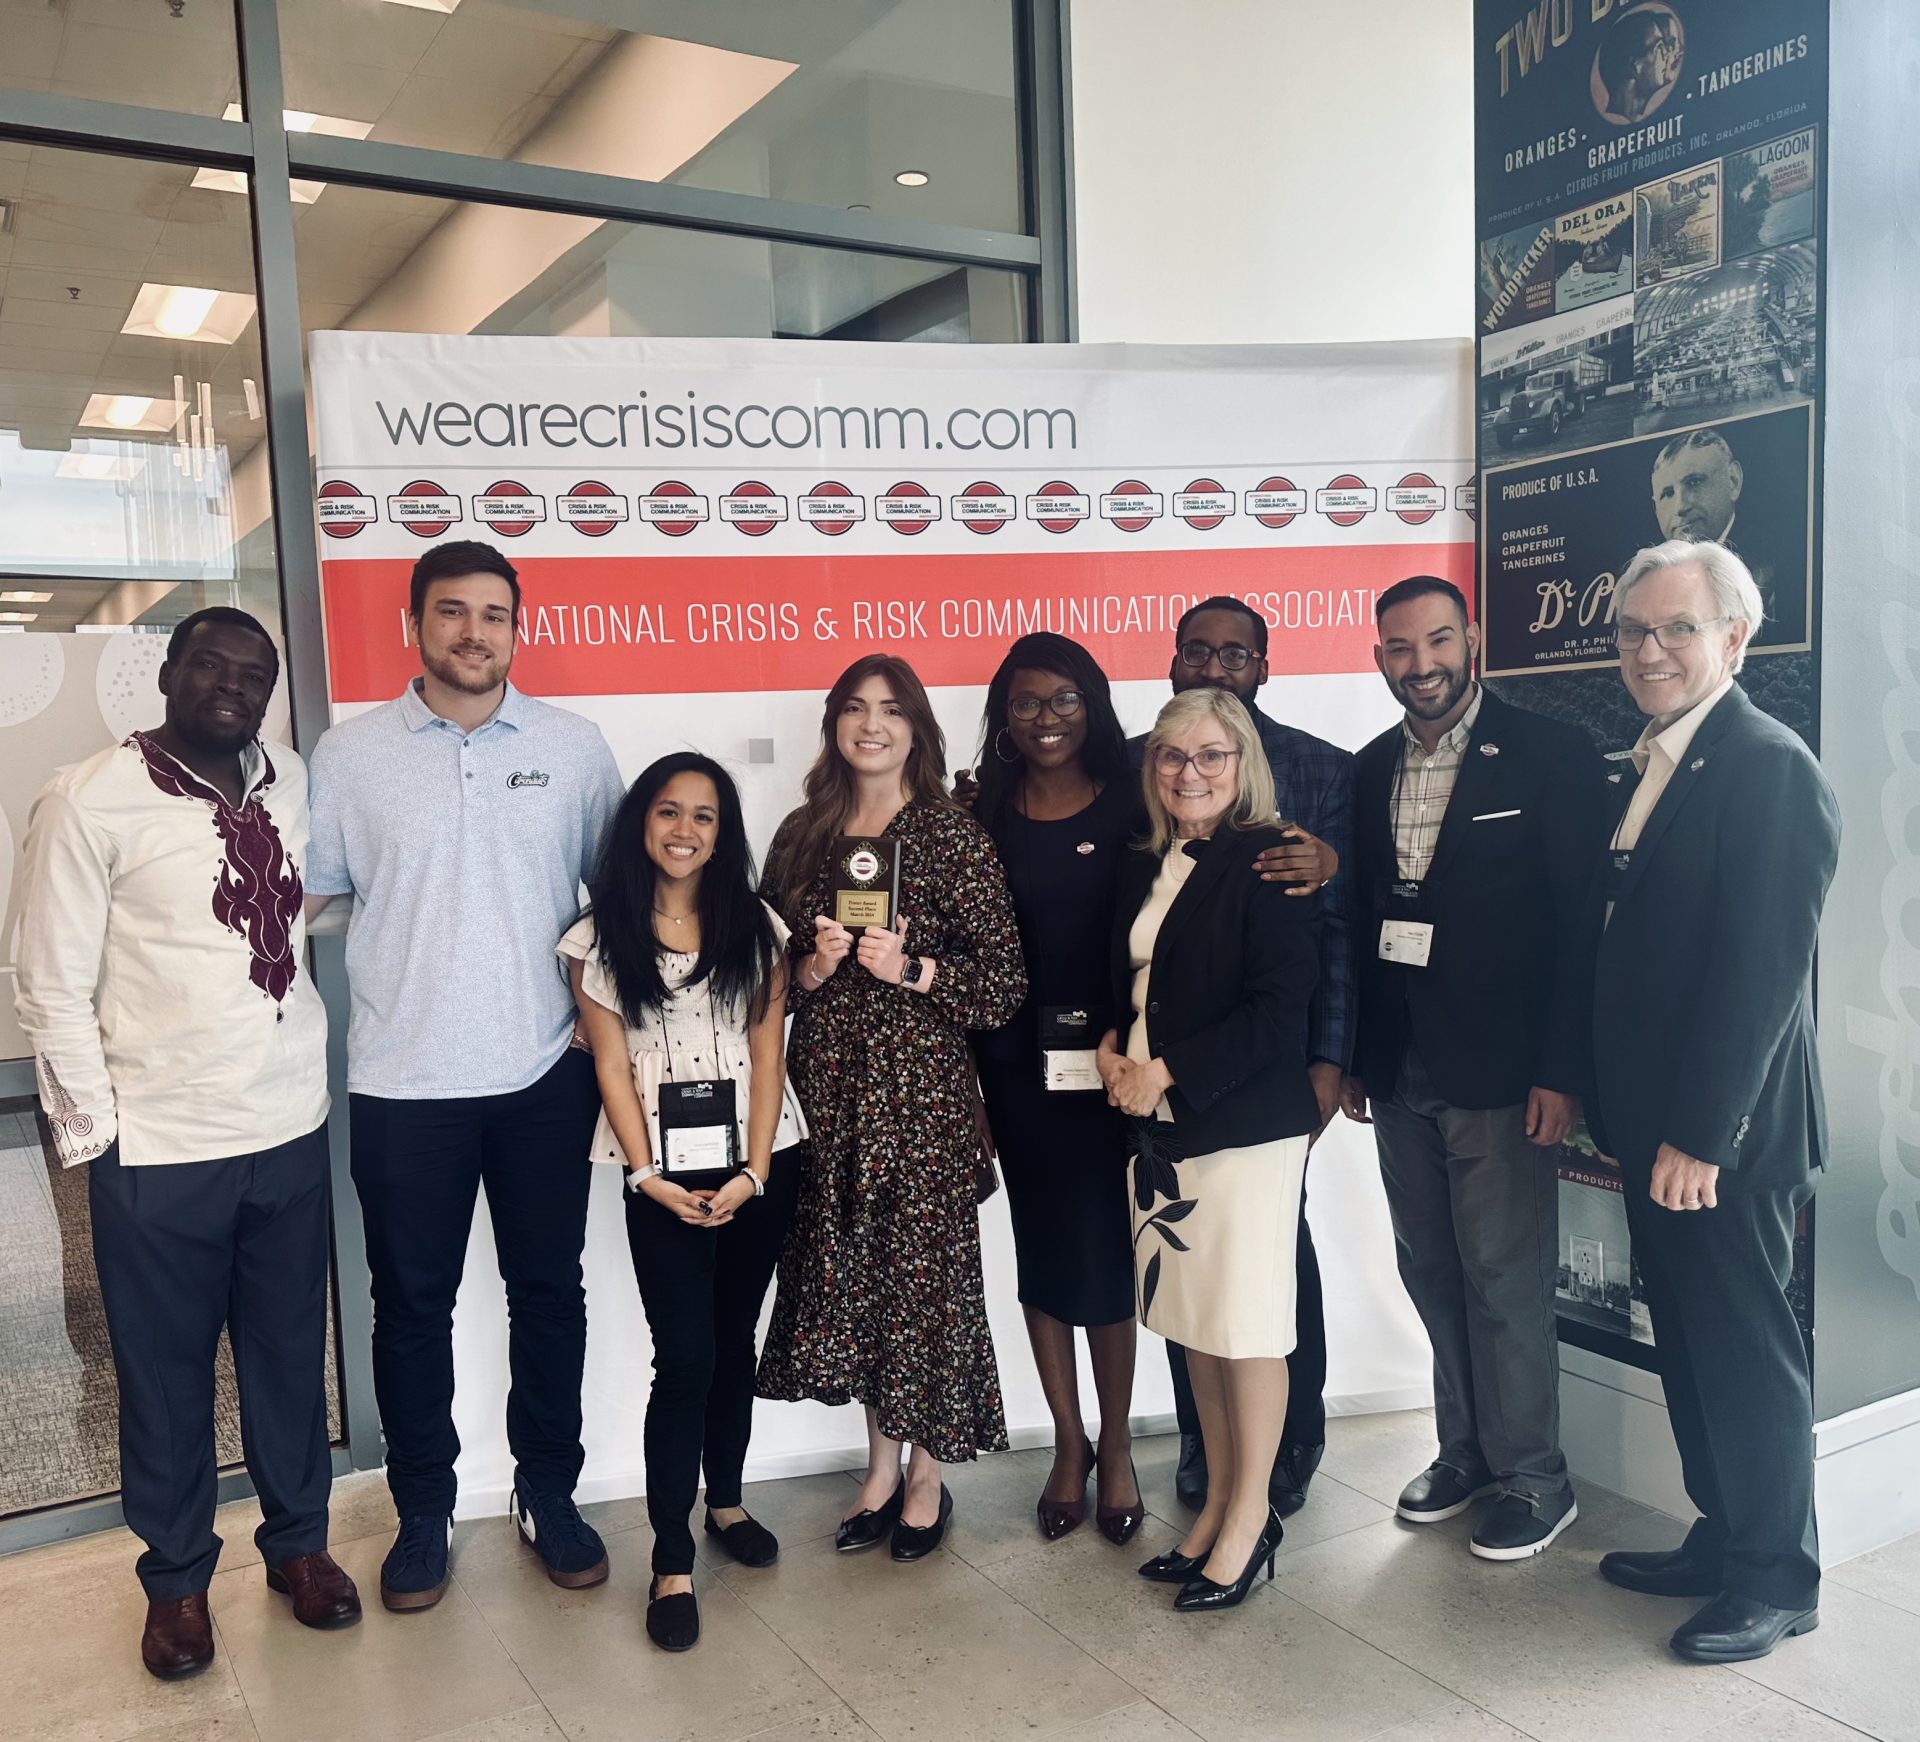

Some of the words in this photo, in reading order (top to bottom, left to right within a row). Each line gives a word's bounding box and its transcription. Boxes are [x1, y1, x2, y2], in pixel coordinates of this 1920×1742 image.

[1496, 0, 1573, 98] TWO
[1698, 34, 1807, 97] TANGERINES
[1505, 127, 1577, 172] ORANGES
[1566, 173, 1599, 196] CITRUS
[1602, 161, 1629, 183] FRUIT
[1690, 133, 1710, 151] INC.
[1766, 102, 1807, 122] FLORIDA
[1588, 114, 1683, 168] GRAPEFRUIT
[1759, 133, 1810, 166] LAGOON
[1561, 213, 1590, 233] DEL
[1595, 201, 1626, 220] ORA
[1482, 226, 1554, 331] WOODPECKER
[1556, 326, 1586, 345] ORANGES
[376, 390, 1076, 450] wearecrisiscomm.com
[1502, 478, 1546, 500] PRODUCE
[1550, 475, 1562, 491] OF
[1502, 524, 1549, 541] ORANGES
[1502, 537, 1565, 556] GRAPEFRUIT
[1502, 552, 1566, 570] TANGERINES
[401, 603, 675, 647] INATIONAL
[688, 602, 799, 643] CRISIS
[814, 608, 837, 640] &
[854, 600, 928, 640] RISK
[940, 594, 1208, 637] COMMUNICATIO
[1529, 578, 1577, 633] Dr.
[1535, 650, 1573, 660] ORLANDO,
[1574, 646, 1608, 656] FLORIDA
[1564, 640, 1580, 648] DR.
[1582, 638, 1590, 646] P.
[1568, 1171, 1624, 1191] PRODUCTS
